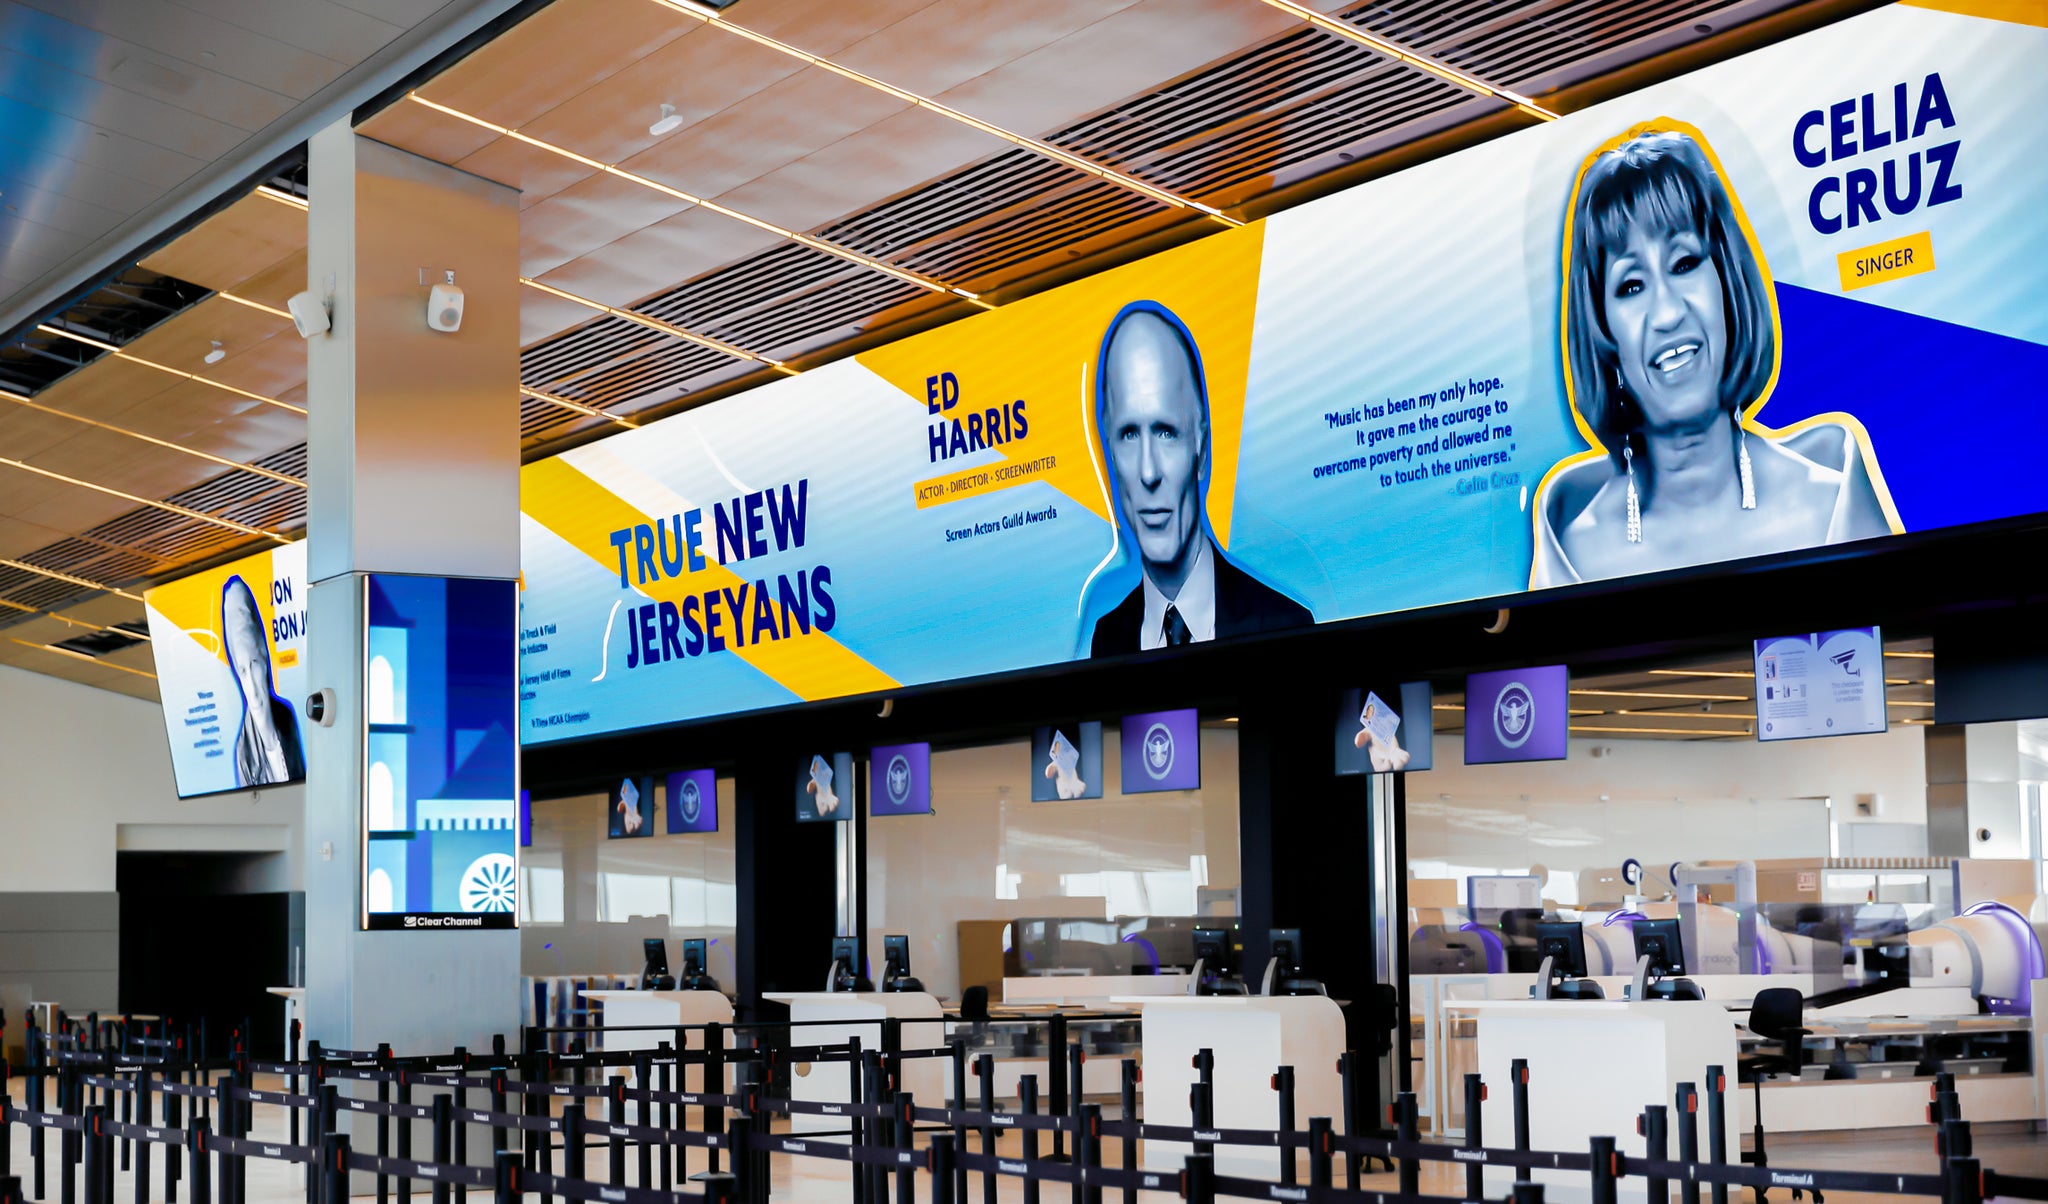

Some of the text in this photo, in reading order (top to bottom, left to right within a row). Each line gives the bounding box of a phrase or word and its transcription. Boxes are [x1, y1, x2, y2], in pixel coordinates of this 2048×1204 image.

[1793, 72, 1956, 168] CELIA
[1808, 140, 1962, 235] CRUZ
[1856, 248, 1914, 277] SINGER
[926, 371, 959, 415] ED
[1325, 377, 1504, 429] "Music has been my only hope.
[928, 400, 1028, 463] HARRIS
[1356, 400, 1508, 447] It gave me the courage to
[1313, 424, 1513, 478] overcome poverty and allowed me
[1380, 443, 1516, 488] to touch the universe."
[918, 456, 1057, 501] ACTOR DIRECTOR SCREENWRITER
[1456, 476, 1488, 495] Celia
[1491, 471, 1520, 490] Cruz
[609, 478, 808, 589] TRUE NEW
[946, 505, 1057, 542] Screen Actors Guild Awards
[269, 576, 293, 606] JON
[272, 612, 298, 643] BON
[626, 565, 836, 669] JERSEYANS
[417, 917, 482, 926] Clear Channel
[1453, 1149, 1482, 1160] Terminal
[1771, 1172, 1814, 1185] Terminal A
